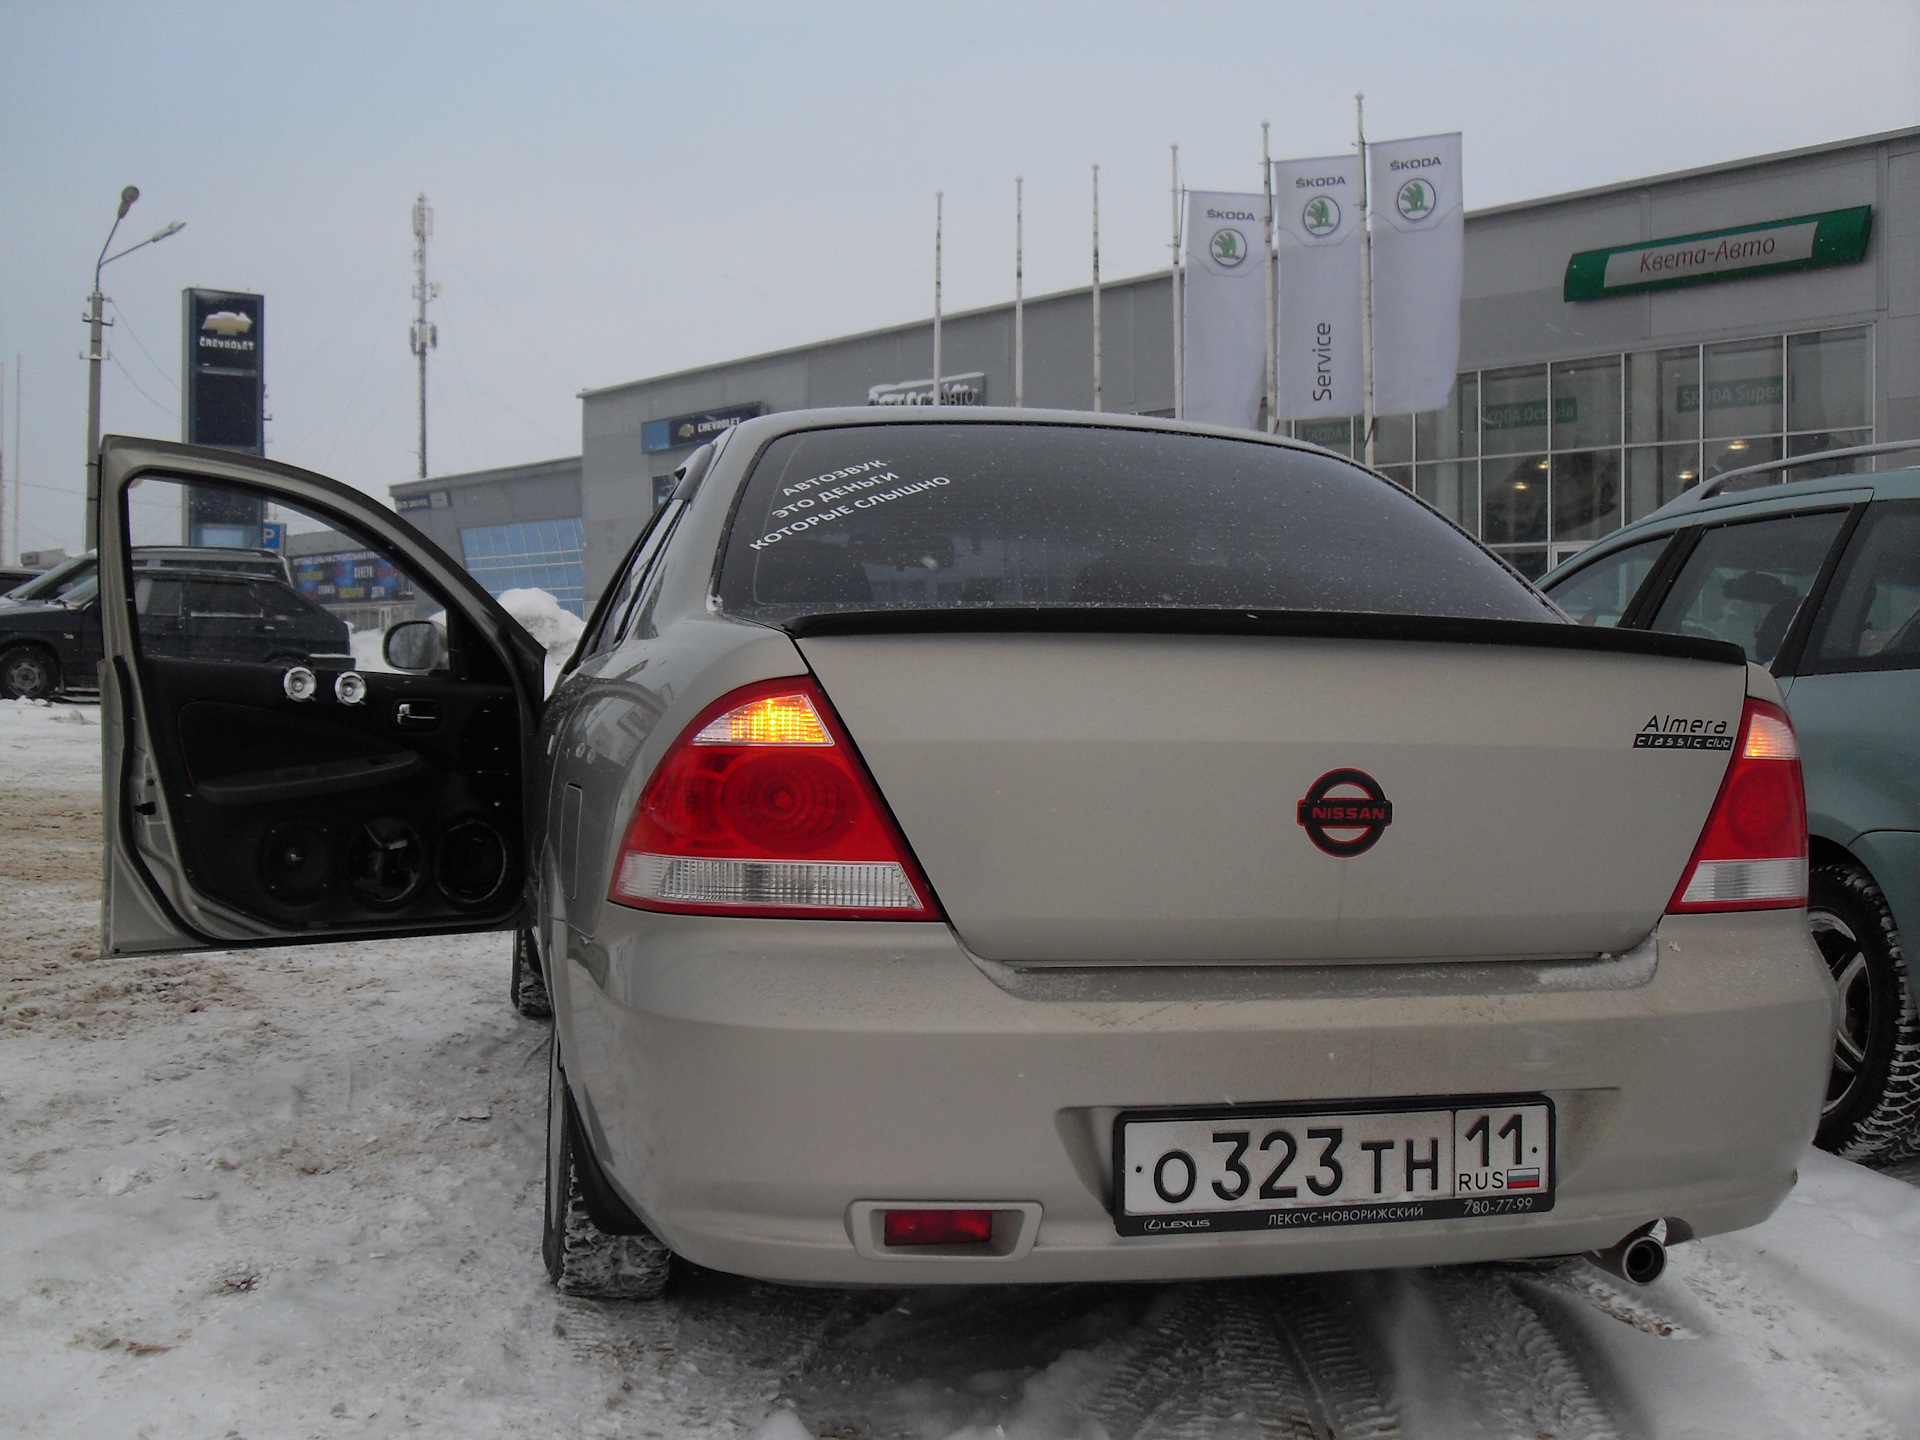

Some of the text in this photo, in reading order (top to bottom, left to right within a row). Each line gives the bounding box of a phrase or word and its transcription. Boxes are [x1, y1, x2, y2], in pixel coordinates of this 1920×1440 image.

[1390, 156, 1442, 171] ŠKODA
[1296, 176, 1346, 189] ŠKODA
[1207, 208, 1255, 222] ŠKODA
[200, 336, 254, 351] CHEVROLET
[1312, 322, 1332, 402] Service
[1735, 382, 1788, 403] Super
[698, 417, 741, 433] CHEVROLET
[781, 458, 888, 498] АВТОЗВУК
[771, 471, 900, 520] ЭТО ДЕНЬГИ
[749, 475, 952, 552] КОТОРЫЕ СЛЫШНО
[1642, 714, 1727, 735] Almera
[1636, 735, 1731, 748] classic club
[1311, 806, 1386, 821] NISSAN
[1465, 1113, 1523, 1168] 11
[1459, 1170, 1504, 1192] RUS
[1268, 1204, 1424, 1226] ЛЕКСУС-НОВОРИЖСКИЙ
[1463, 1197, 1533, 1216] 780-77-99
